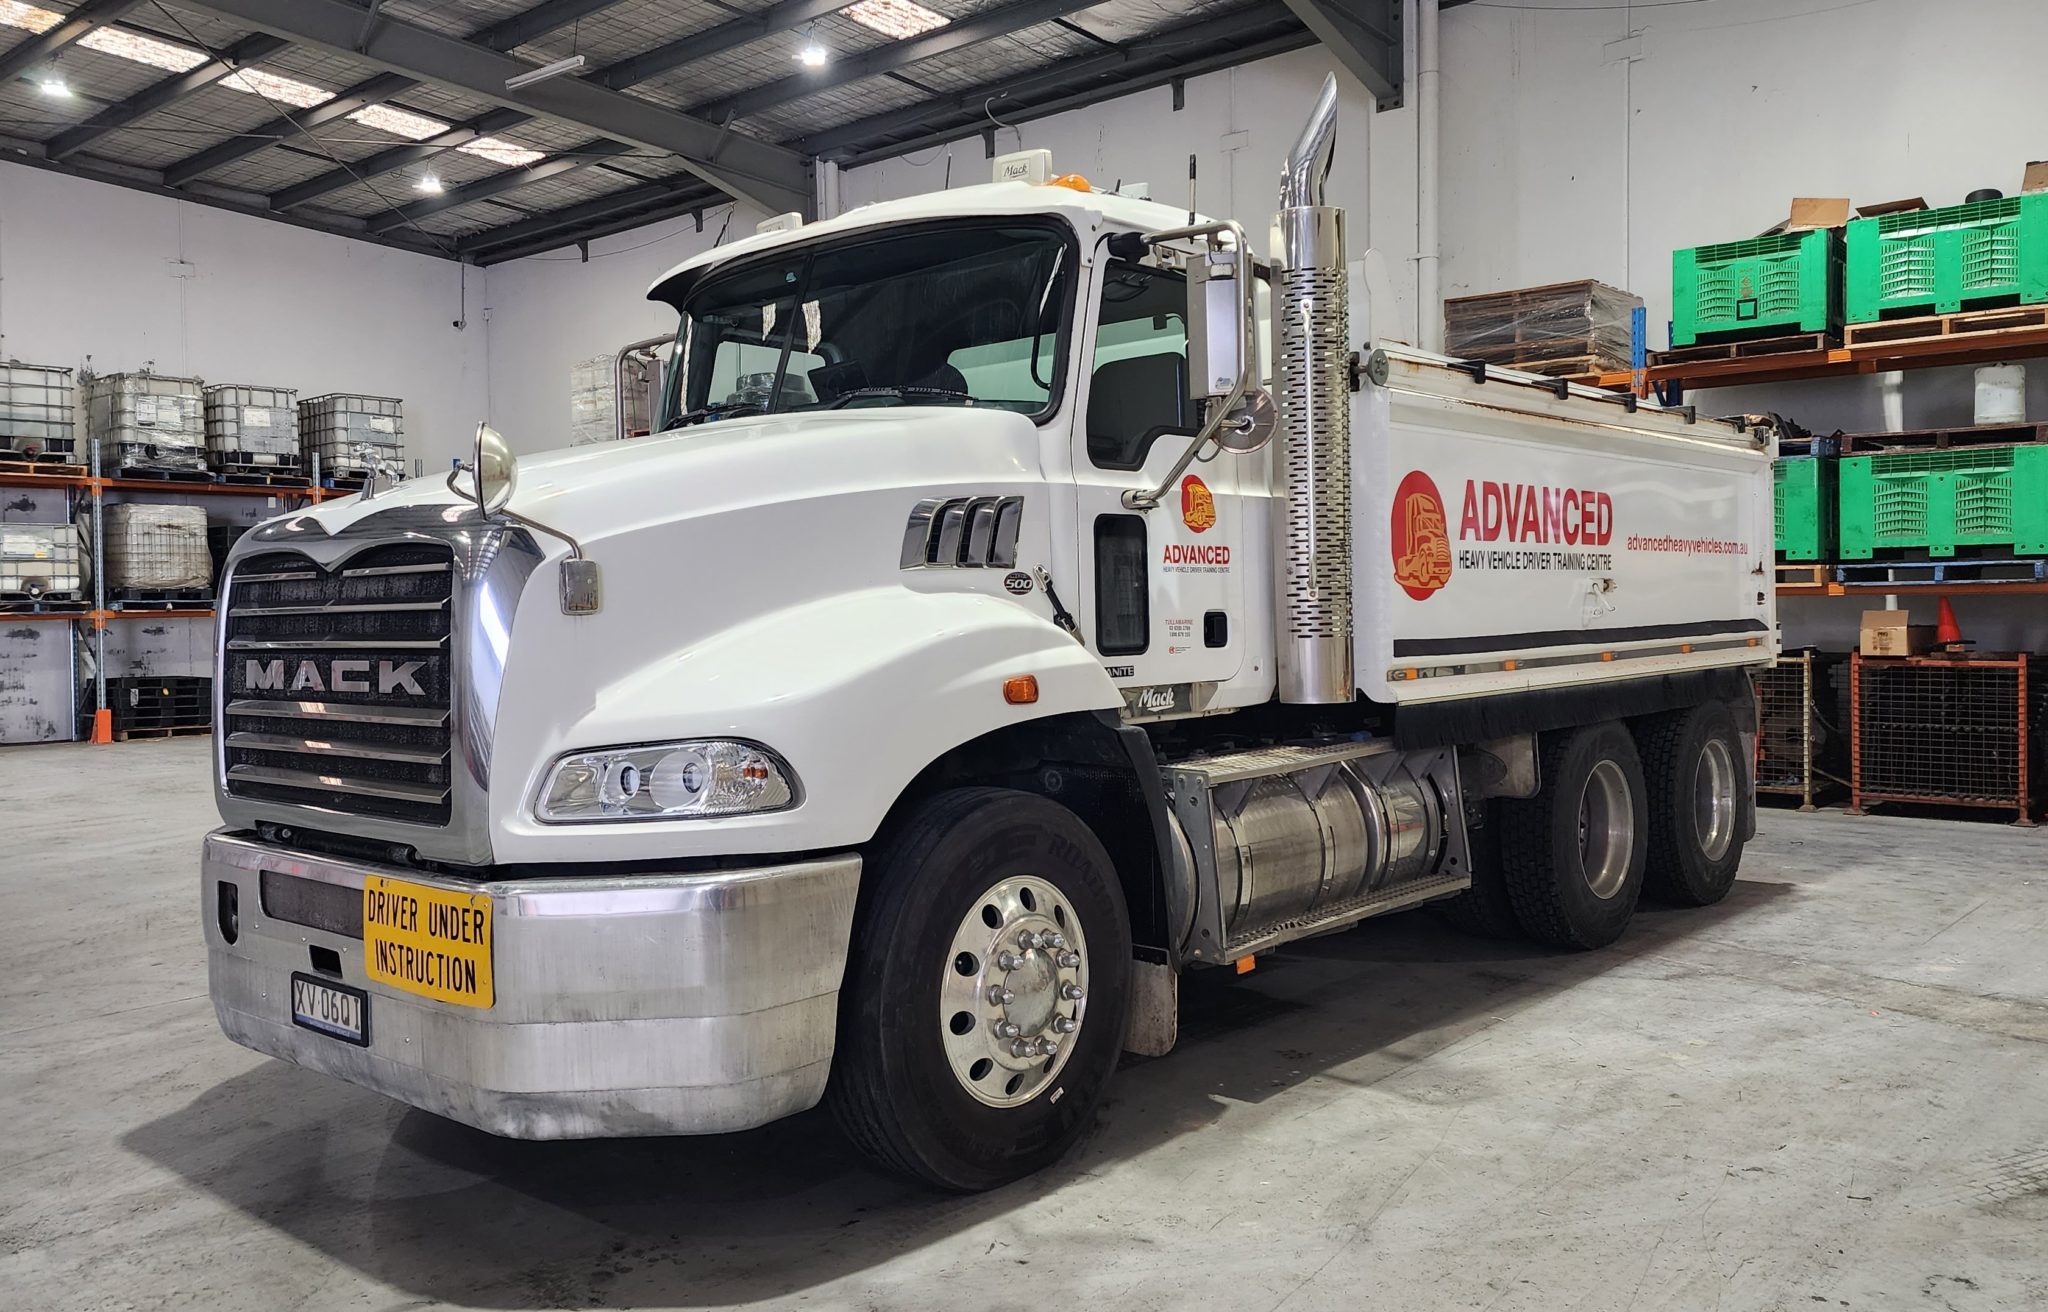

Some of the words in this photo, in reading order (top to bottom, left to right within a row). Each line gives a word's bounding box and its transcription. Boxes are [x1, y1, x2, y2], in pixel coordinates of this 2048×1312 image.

[1003, 163, 1028, 178] Mack
[1459, 479, 1613, 546] ADVANCED
[1163, 544, 1230, 564] ADVANCED
[1627, 533, 1748, 556] advancedheavyvehicles.com.au
[1175, 566, 1190, 574] VEHICLE
[1190, 566, 1202, 574] DRIVER
[1203, 566, 1218, 574] TRAINING
[1459, 550, 1485, 569] HEAVY
[1487, 551, 1521, 570] VEHICLE
[1522, 552, 1551, 570] DRIVER
[1553, 553, 1585, 571] TRAINING
[1587, 553, 1612, 571] CENTRE
[1006, 579, 1033, 589] 500
[245, 659, 427, 696] MACK
[1138, 687, 1175, 712] Mack
[368, 889, 418, 933] DRIVER
[428, 901, 485, 945] UNDER
[375, 938, 477, 995] INSTRUCTION
